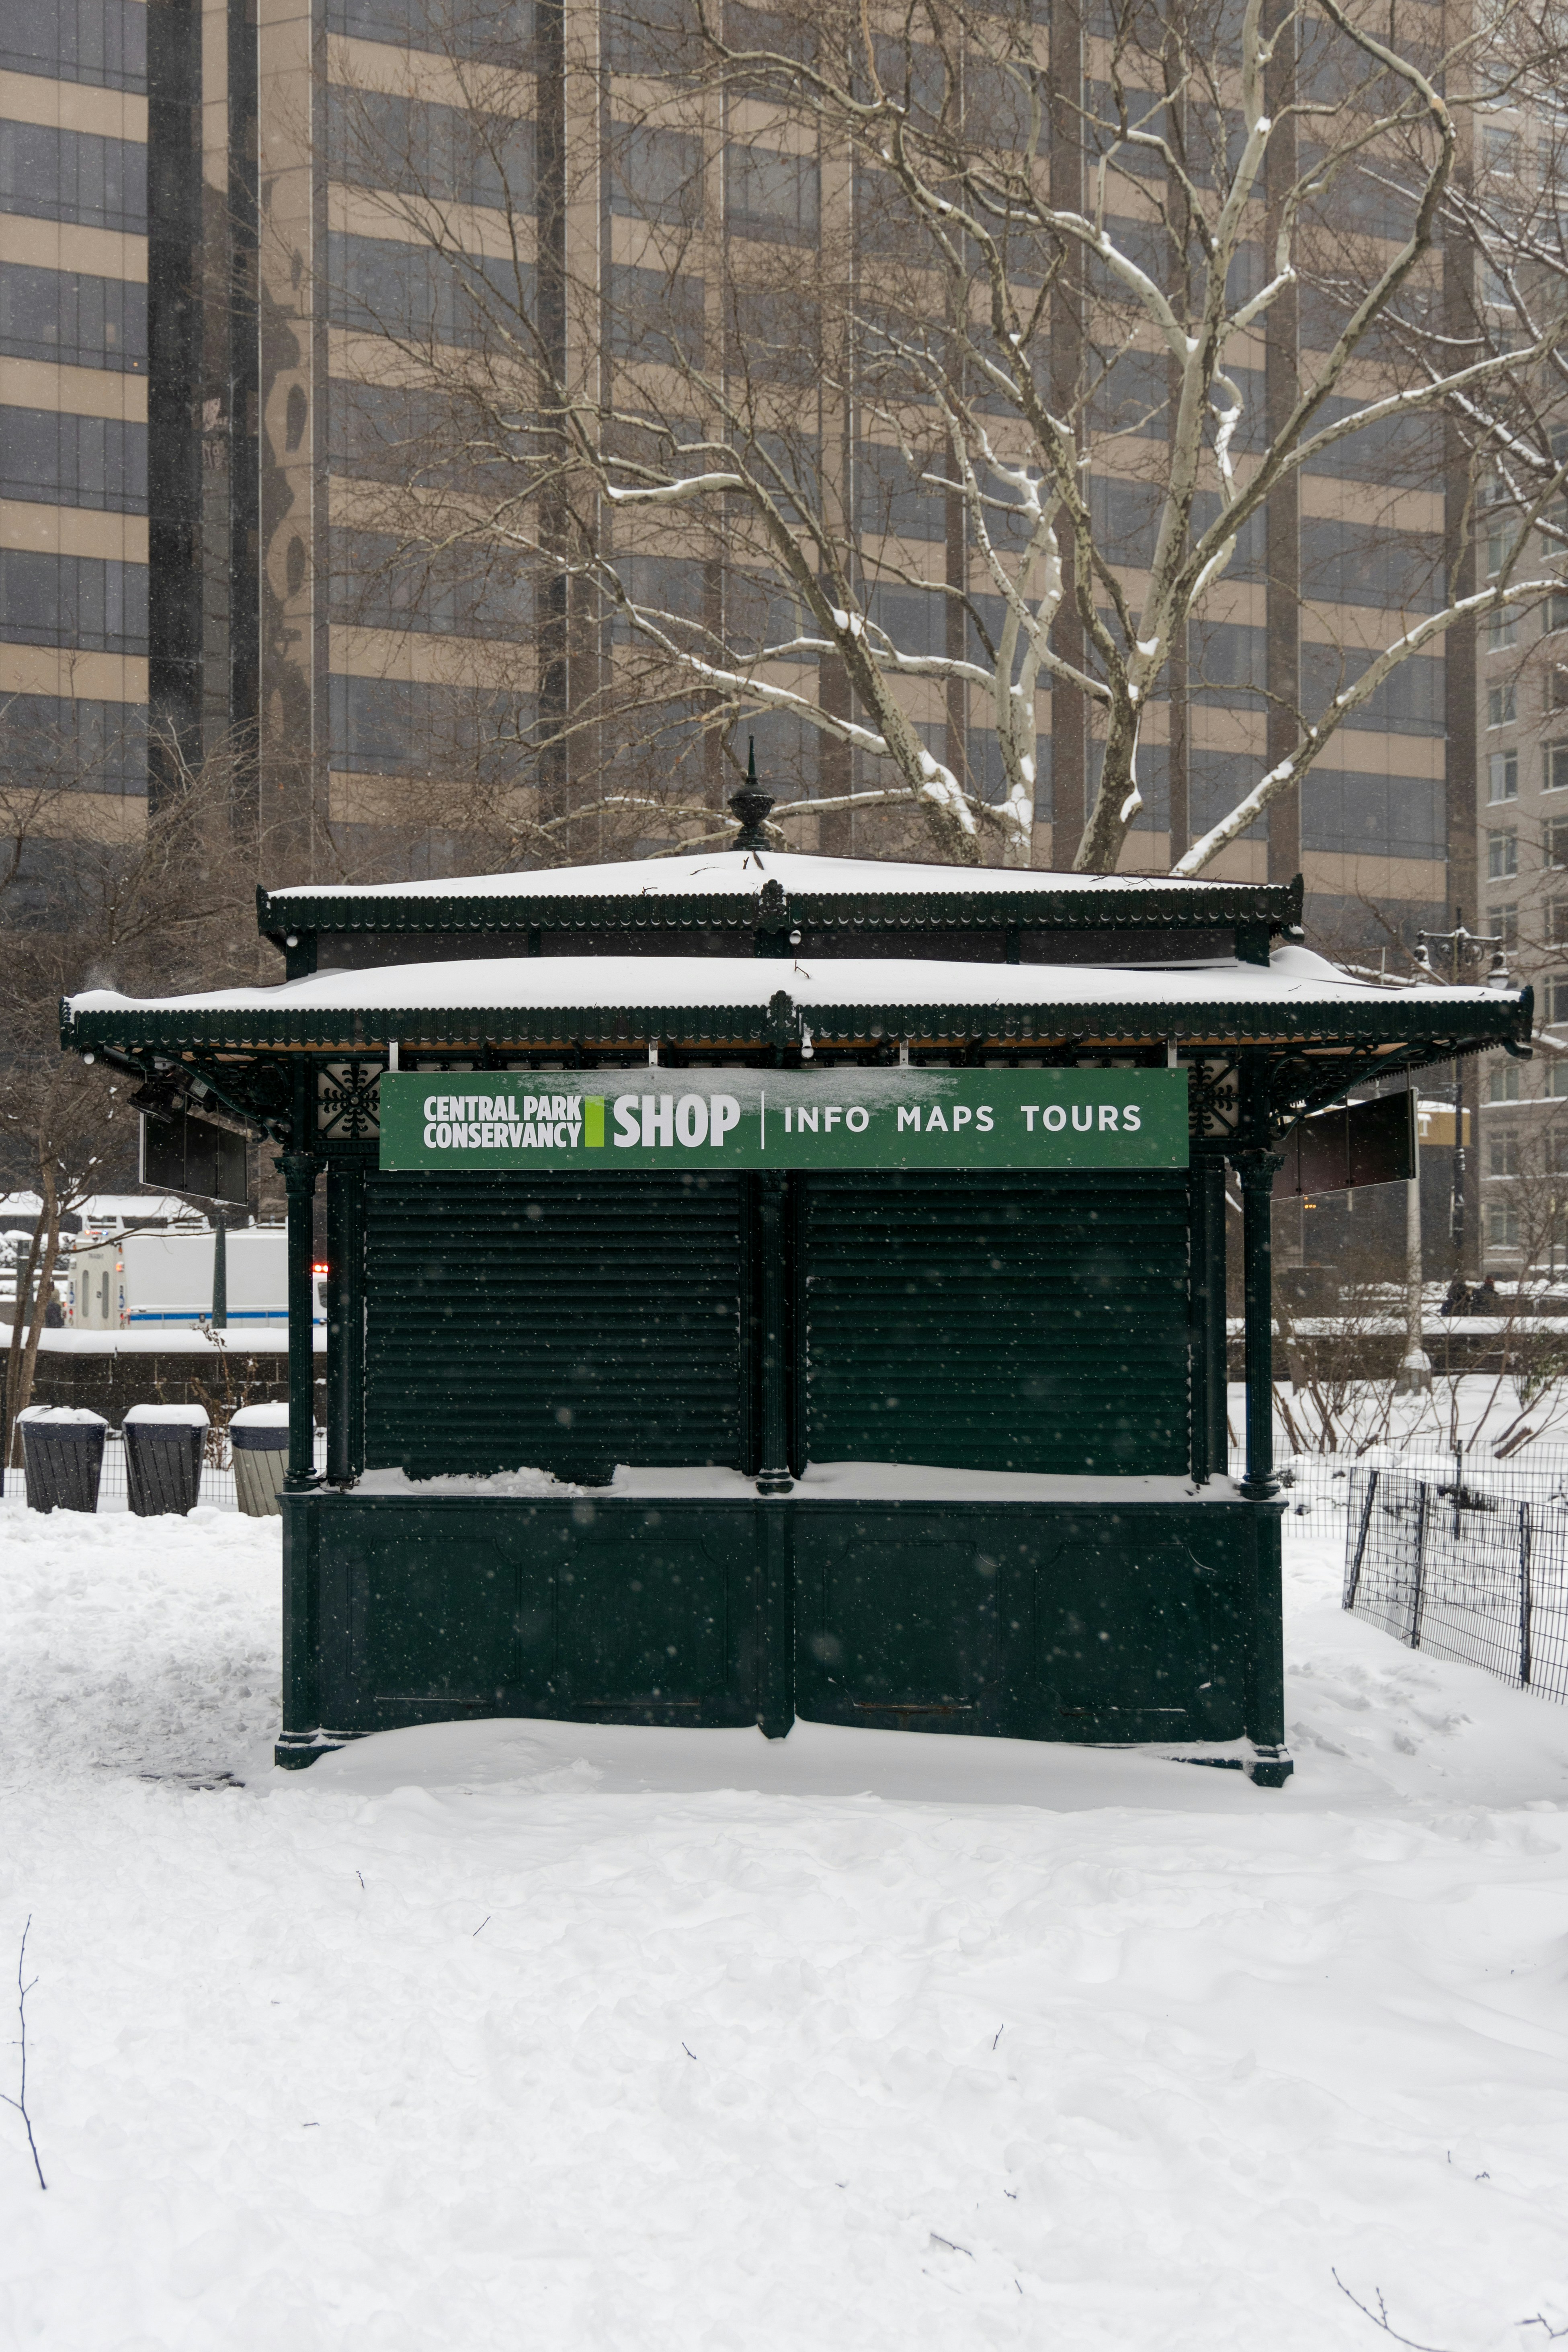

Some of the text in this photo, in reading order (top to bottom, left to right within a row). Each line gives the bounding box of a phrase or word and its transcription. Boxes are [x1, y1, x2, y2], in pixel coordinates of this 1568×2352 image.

[424, 1096, 582, 1121] CENTRAL PARK
[613, 1094, 740, 1147] SHOP
[785, 1105, 1141, 1132] INFO MAPS TOURS
[424, 1122, 582, 1148] CONSERVANCY
